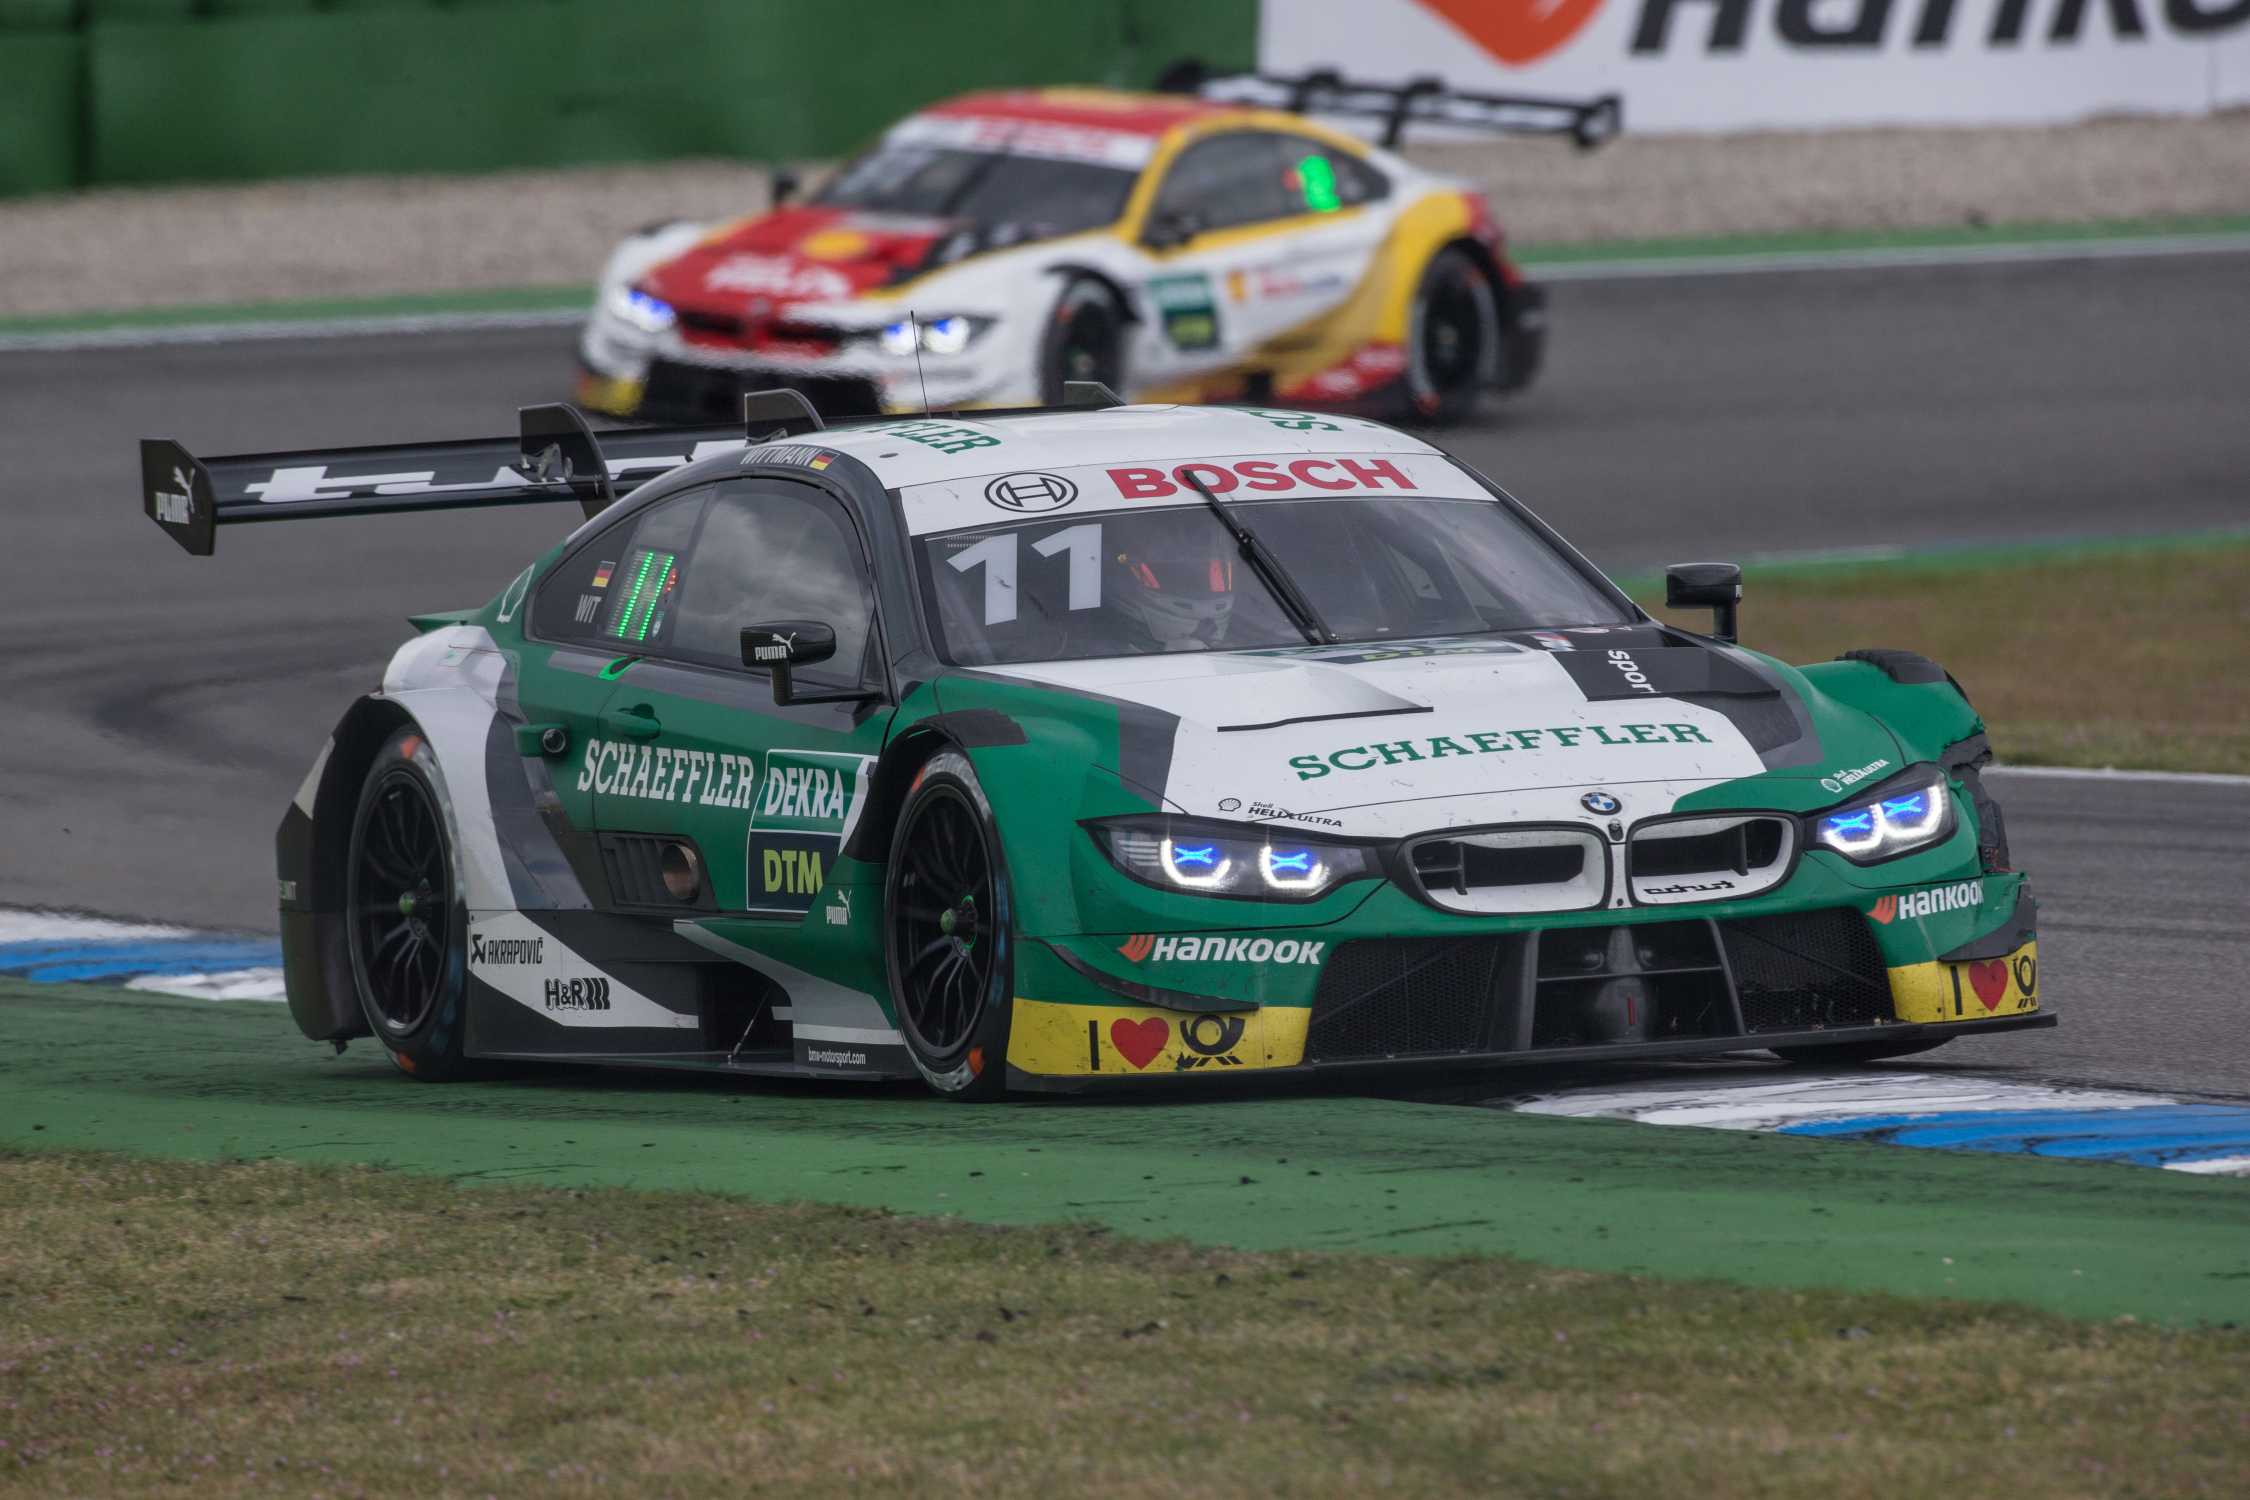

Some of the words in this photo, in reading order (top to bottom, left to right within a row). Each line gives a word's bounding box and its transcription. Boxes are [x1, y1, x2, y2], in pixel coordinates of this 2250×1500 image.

[1106, 458, 1418, 500] BOSCH
[946, 523, 1102, 626] 11
[754, 645, 787, 661] PUMA
[1608, 649, 1661, 694] spor
[1287, 722, 1712, 781] SCHAEFFLER
[577, 738, 755, 810] SCHAEFFLER
[764, 767, 845, 819] DEKRA
[1253, 801, 1274, 809] Shell
[1297, 813, 1343, 827] ULTRA
[763, 849, 823, 895] DTM
[826, 905, 849, 925] PUMA
[544, 978, 588, 1011] H&R
[808, 1046, 867, 1068] bmw-motorsport.com
